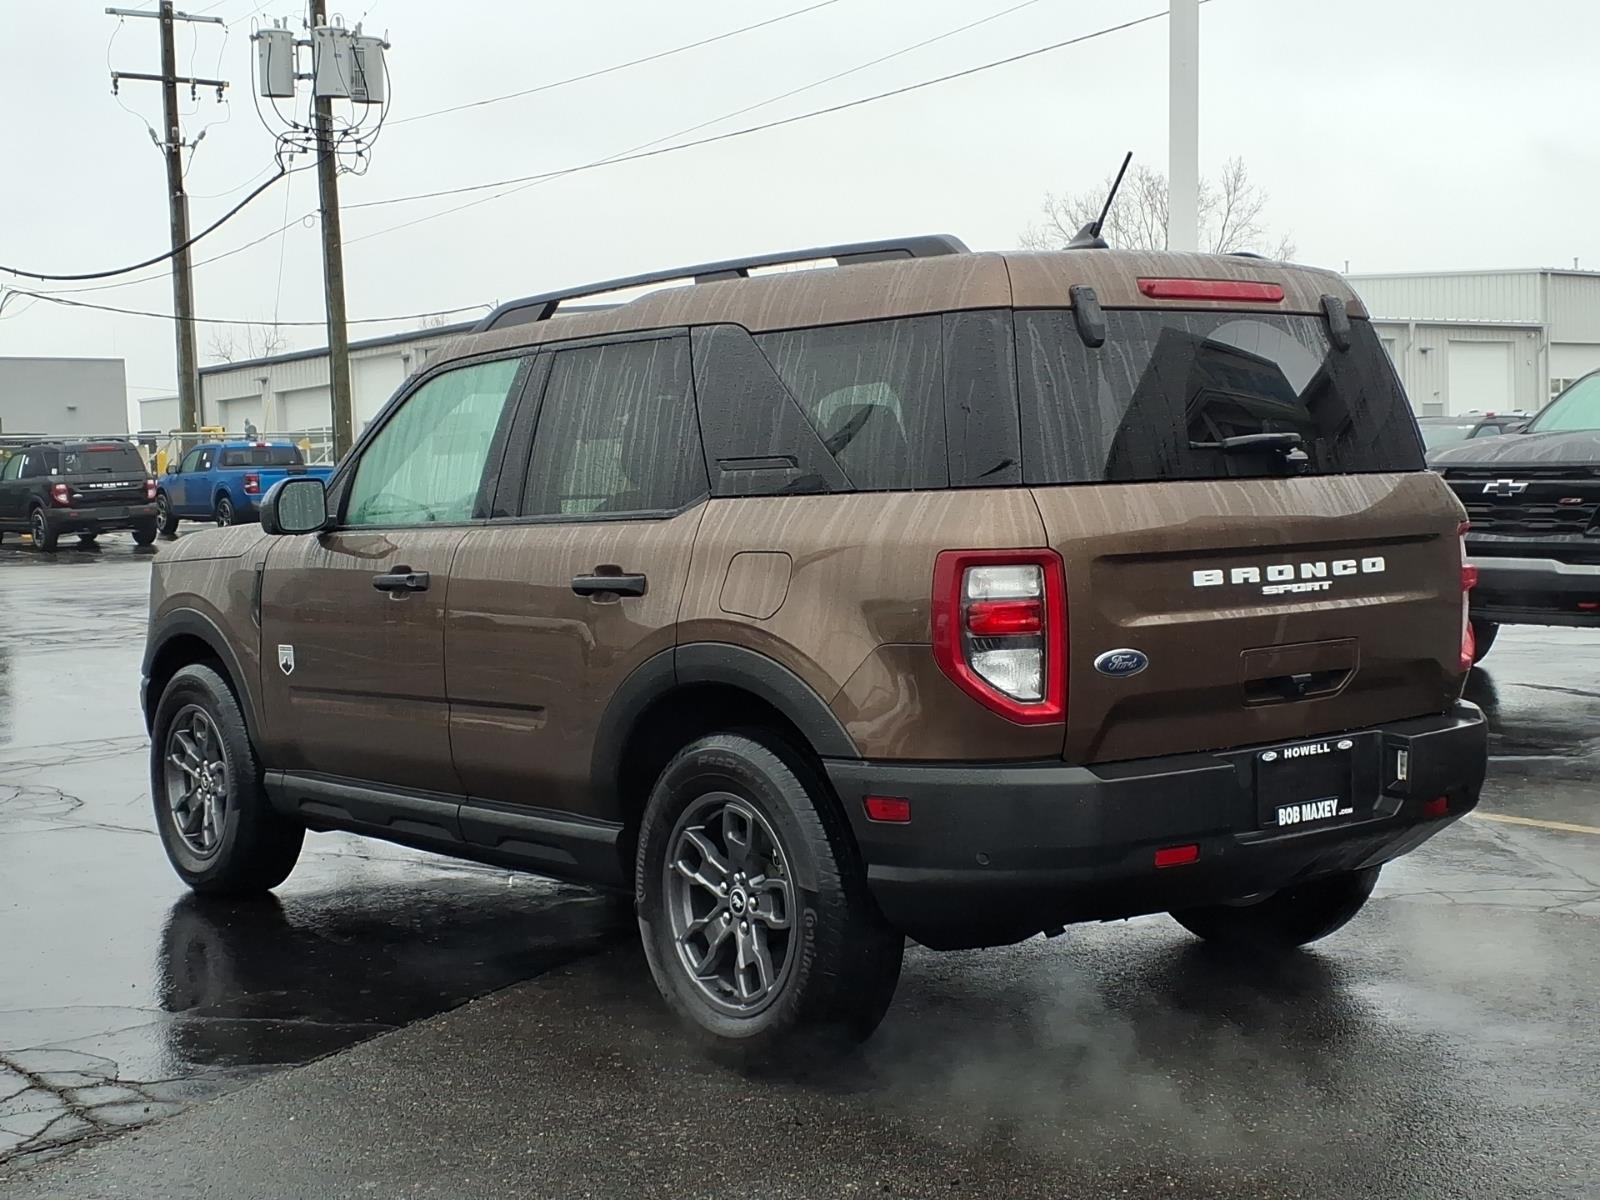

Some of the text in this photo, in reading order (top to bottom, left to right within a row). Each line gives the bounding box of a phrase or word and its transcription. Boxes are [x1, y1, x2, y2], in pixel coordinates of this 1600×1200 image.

[1193, 556, 1385, 586] BRONCO
[1262, 581, 1333, 595] SPORT
[1284, 743, 1330, 759] HOWELL
[1279, 806, 1300, 826] BOB
[1302, 799, 1338, 821] MAXEY
